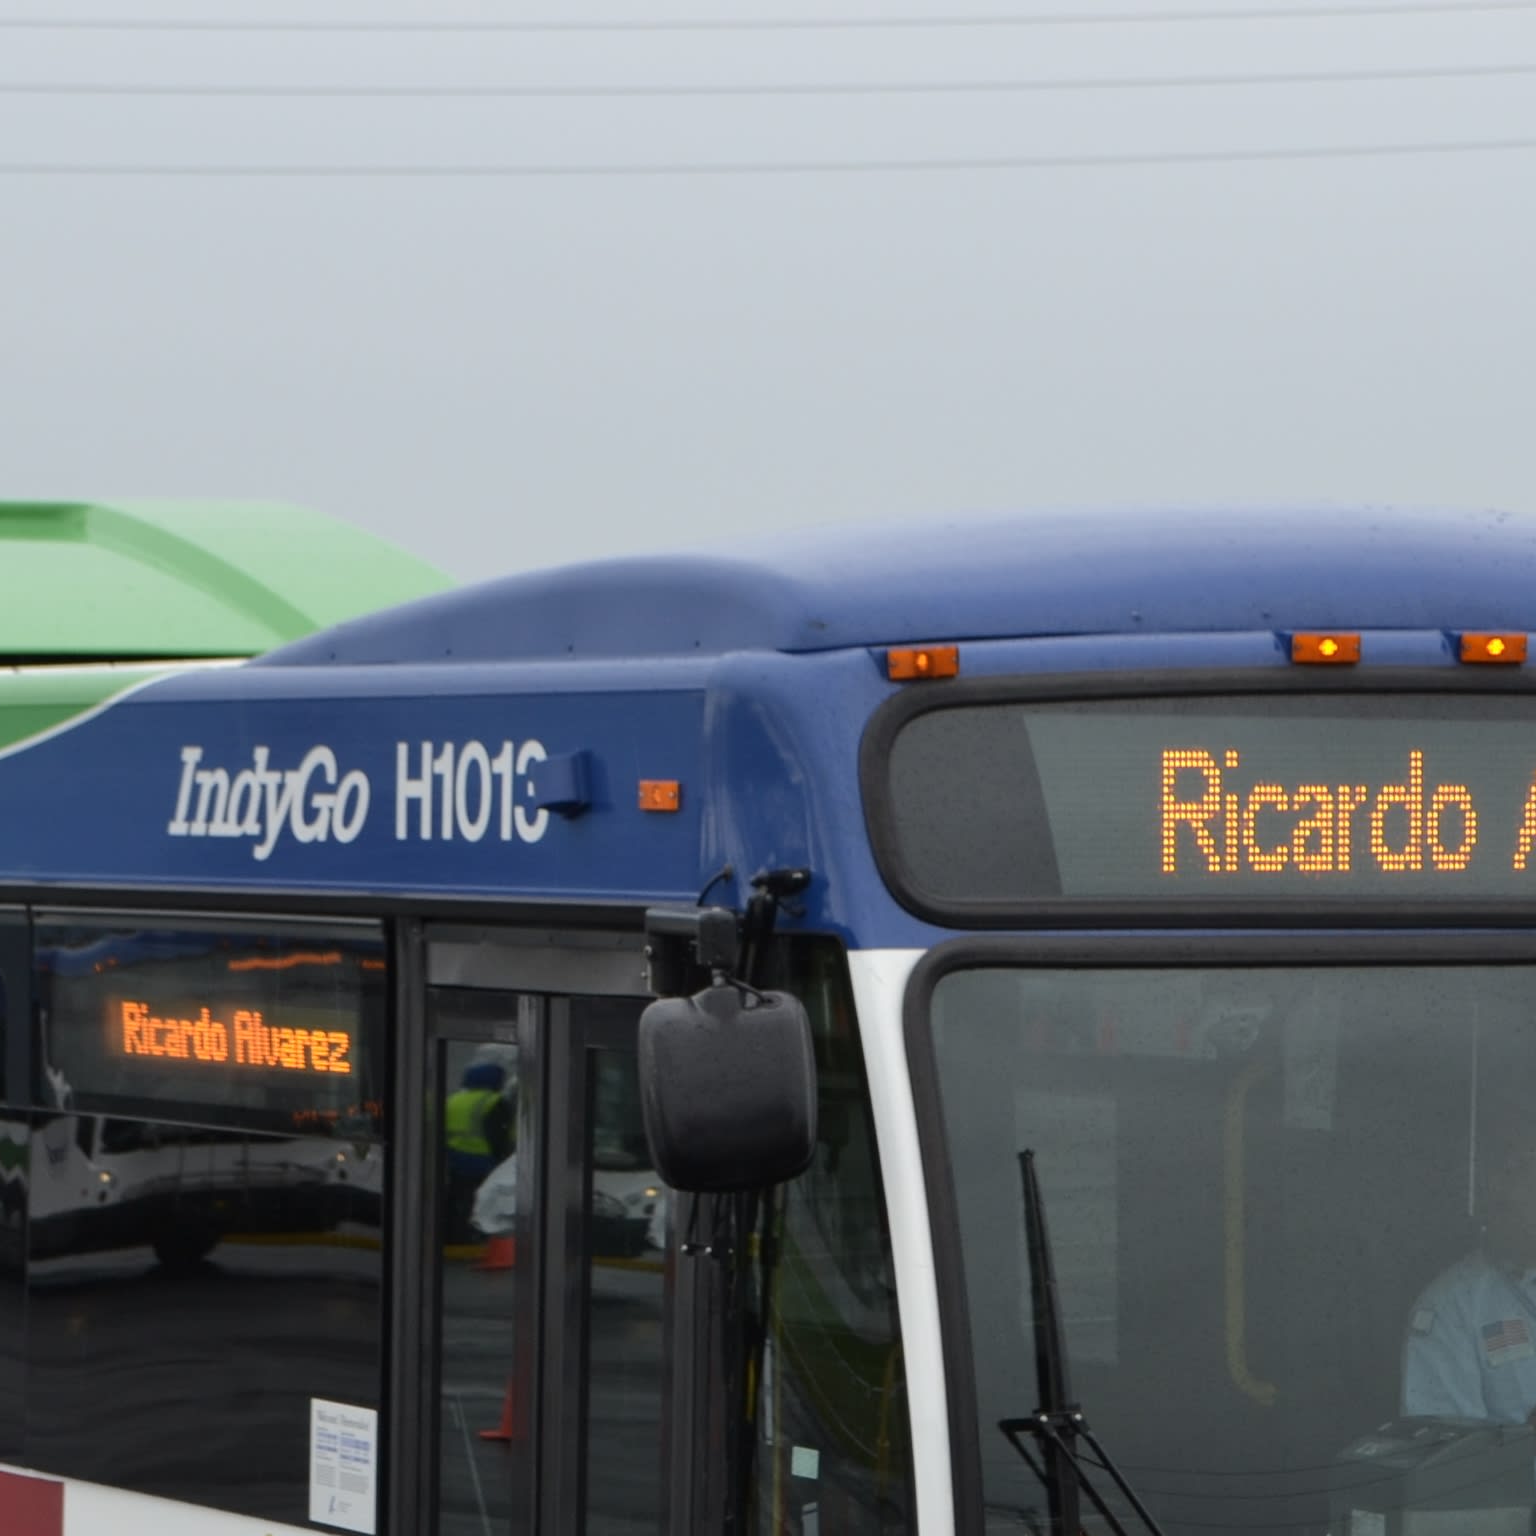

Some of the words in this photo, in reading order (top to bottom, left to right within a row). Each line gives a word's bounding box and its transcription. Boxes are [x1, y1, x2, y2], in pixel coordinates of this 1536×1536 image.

[168, 744, 370, 861] IndyGo
[395, 739, 550, 844] H1013
[1158, 747, 1478, 874] Ricardo
[121, 1001, 228, 1062] Ricardo
[236, 1009, 352, 1075] Alvarez
